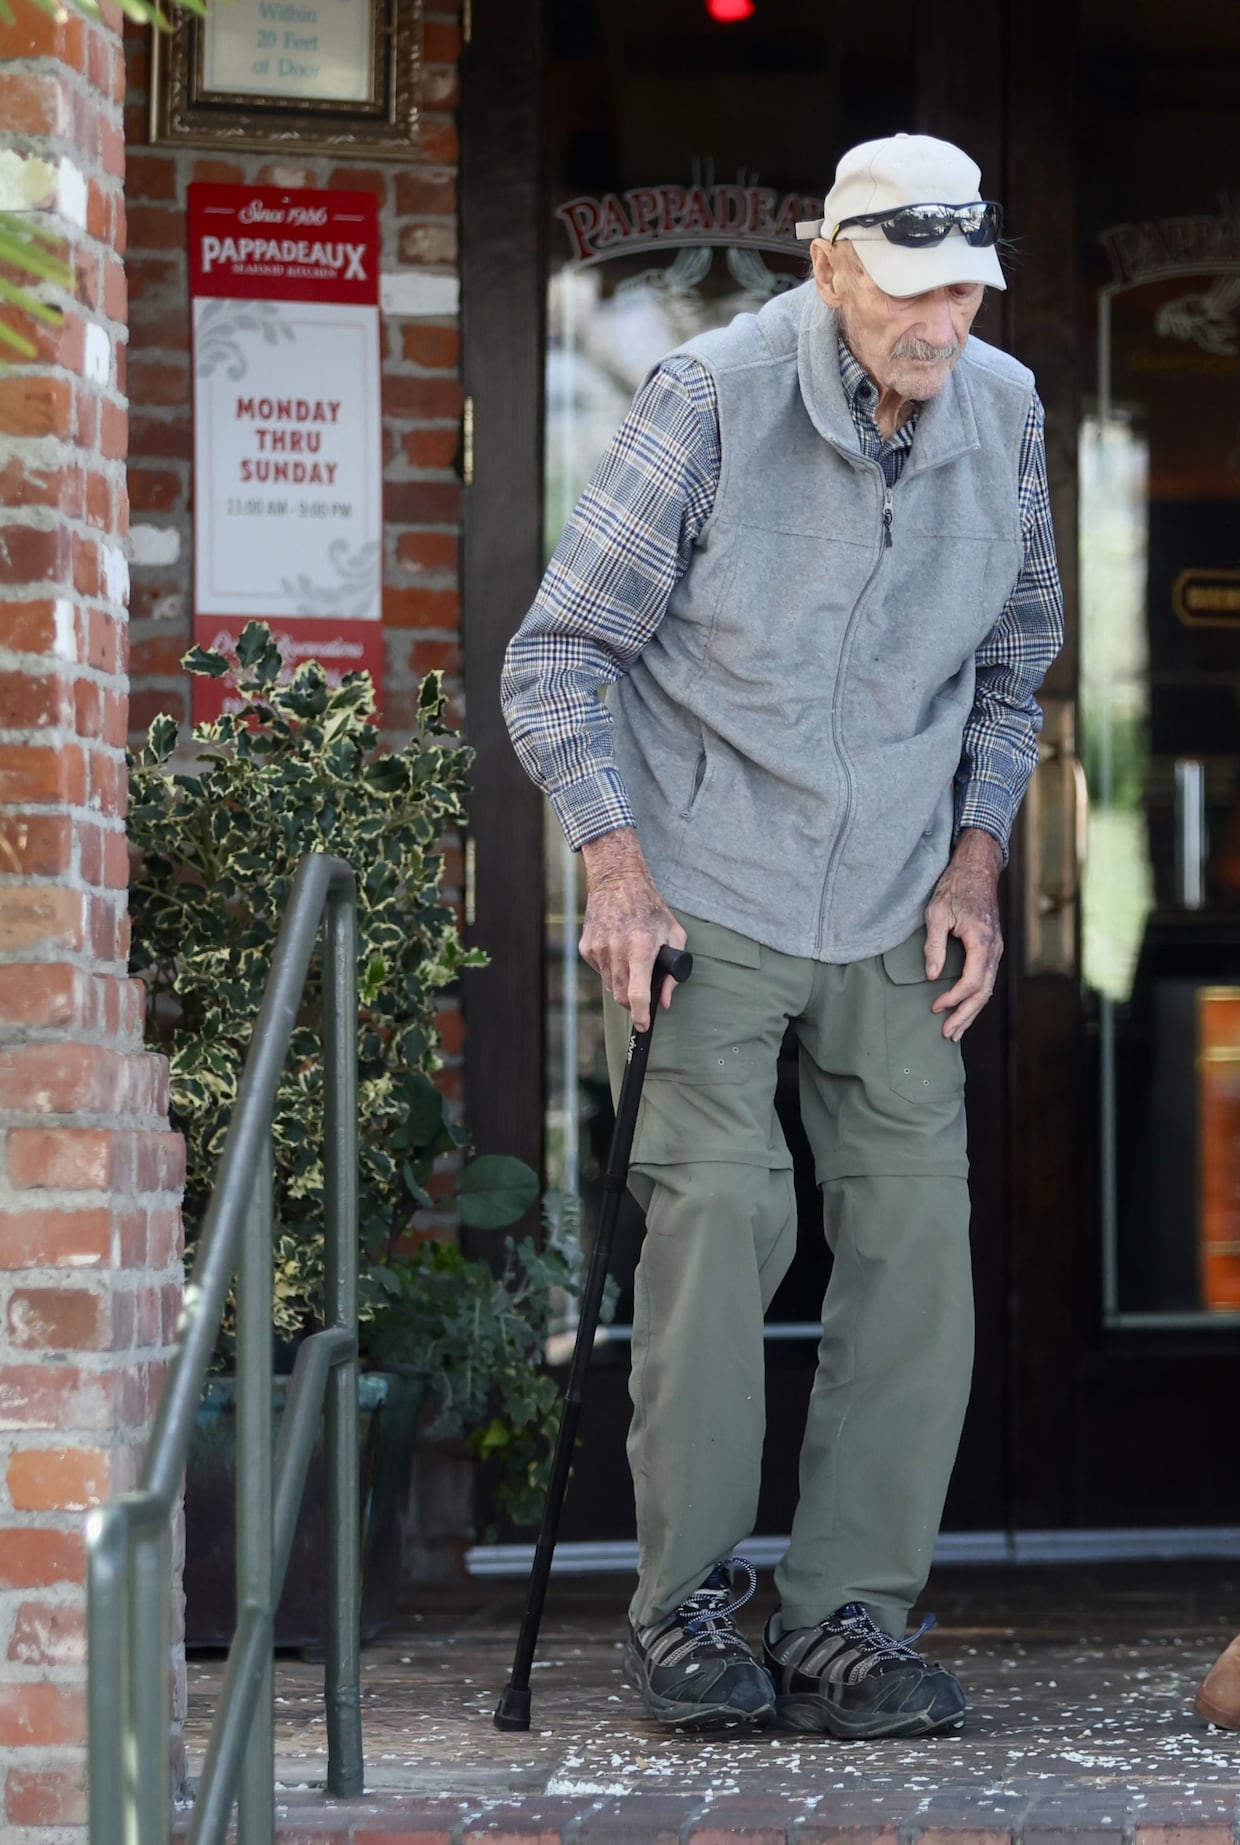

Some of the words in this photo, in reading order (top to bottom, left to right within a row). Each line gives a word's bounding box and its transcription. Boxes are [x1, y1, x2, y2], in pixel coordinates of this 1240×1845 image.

[256, 30, 277, 49] 20
[283, 31, 318, 51] Feet
[252, 58, 270, 76] of
[277, 58, 319, 77] Door
[238, 199, 285, 225] Since
[202, 235, 367, 281] PAPPADEAUX
[235, 396, 341, 425] MONDAY
[255, 429, 322, 454] THRU
[240, 459, 338, 487] SUNDAY
